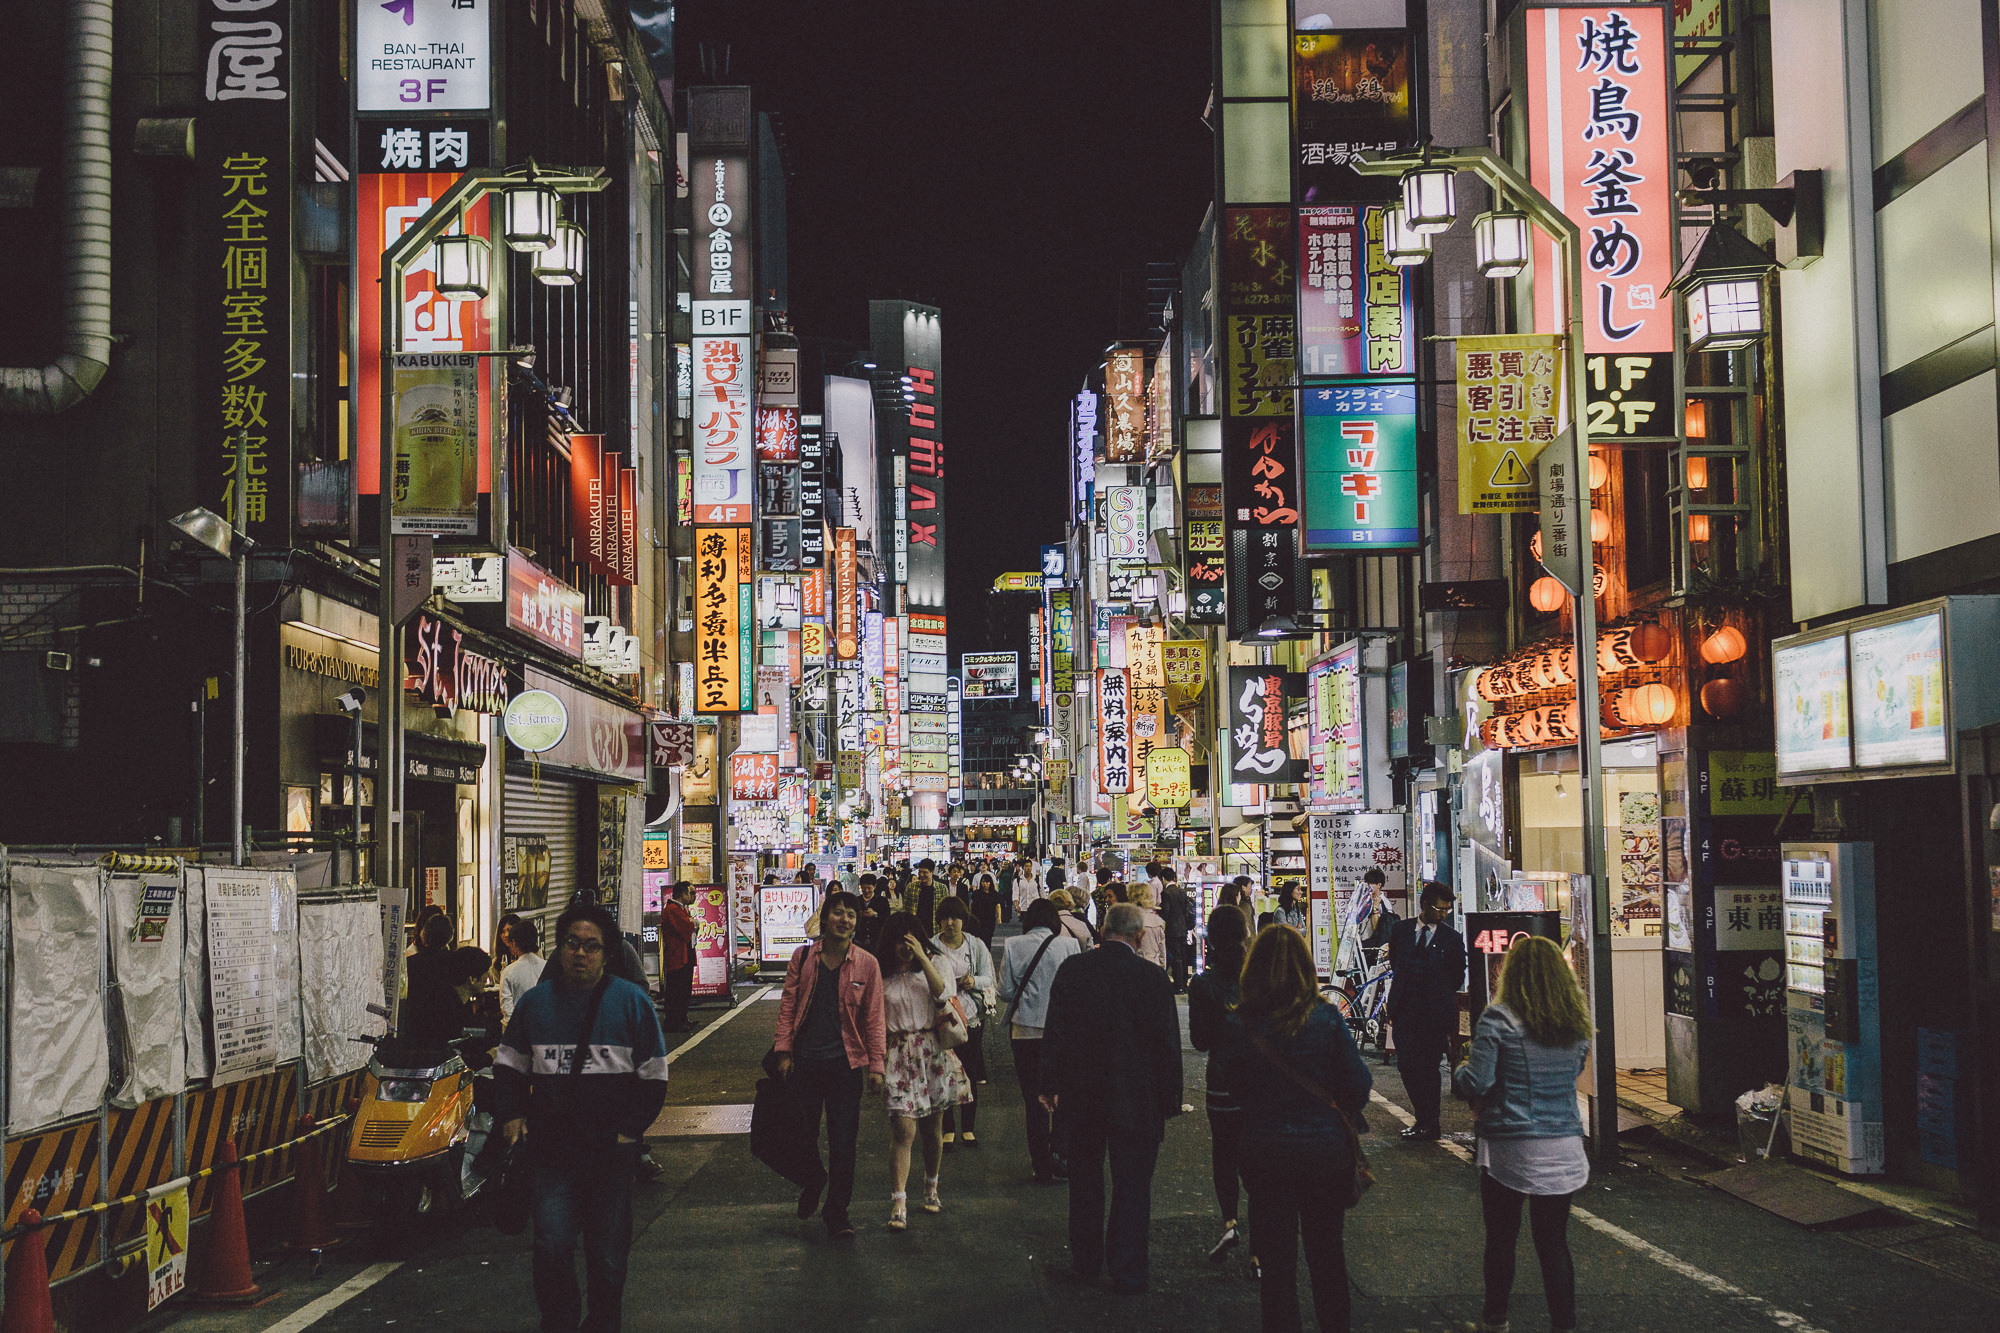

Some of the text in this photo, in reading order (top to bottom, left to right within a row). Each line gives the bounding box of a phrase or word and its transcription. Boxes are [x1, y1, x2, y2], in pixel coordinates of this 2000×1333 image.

[384, 43, 464, 55] BAN-THAI
[1302, 42, 1316, 51] 2F
[371, 58, 475, 70] RESTAURANT
[400, 79, 447, 103] 3F
[380, 128, 468, 168] 焼肉
[1576, 12, 1646, 342] 焼鳥釜めし
[1310, 217, 1355, 226] 無料案内所
[709, 228, 733, 294] 高田屋
[1308, 233, 1322, 288] ホテル可
[701, 309, 742, 326] B1F
[222, 152, 268, 524] 完全個室多数完備
[1261, 317, 1294, 360] 麻雀
[1307, 344, 1336, 373] 1F
[1467, 352, 1553, 379] 悪質な
[1586, 356, 1652, 391] 1F
[699, 340, 747, 466] 熟女キャバクラ
[1318, 388, 1400, 400] オンライン
[1336, 401, 1384, 412] カフェ
[1467, 384, 1554, 411] 客引き
[761, 408, 797, 431] 湖南
[1467, 416, 1555, 443] に注意
[1586, 401, 1655, 435] 2F
[774, 451, 787, 459] 4F
[396, 453, 410, 502] 一番搾り
[1340, 421, 1382, 524] ラッキー
[590, 478, 601, 557] ANRAKUTEI
[708, 506, 738, 523] 4F
[1550, 463, 1567, 557] 劇場通り一番街
[606, 495, 618, 570] ANRAKUTEI
[772, 521, 788, 558] エデン
[1190, 522, 1221, 535] 麻雀
[1352, 531, 1373, 542] B1
[622, 509, 633, 581] ANRAKUTEI
[739, 534, 750, 576] 炭火串焼
[1262, 532, 1278, 567] 割烹
[1053, 591, 1073, 691] まんが喫茶
[1165, 647, 1201, 659] 悪質な
[1166, 660, 1202, 671] 客引き
[1167, 673, 1202, 685] に注意
[1263, 675, 1284, 749] 東京豚骨
[1102, 674, 1128, 788] 無料案内所
[734, 755, 776, 779] 湖南
[743, 780, 776, 800] 菜館
[1700, 771, 1708, 794] 5F
[1314, 819, 1351, 829] 2015年
[1375, 851, 1398, 861] 危険
[1701, 839, 1709, 862] 4F
[1705, 907, 1713, 929] 3F
[1474, 930, 1509, 954] 4F
[1707, 976, 1715, 998] B1
